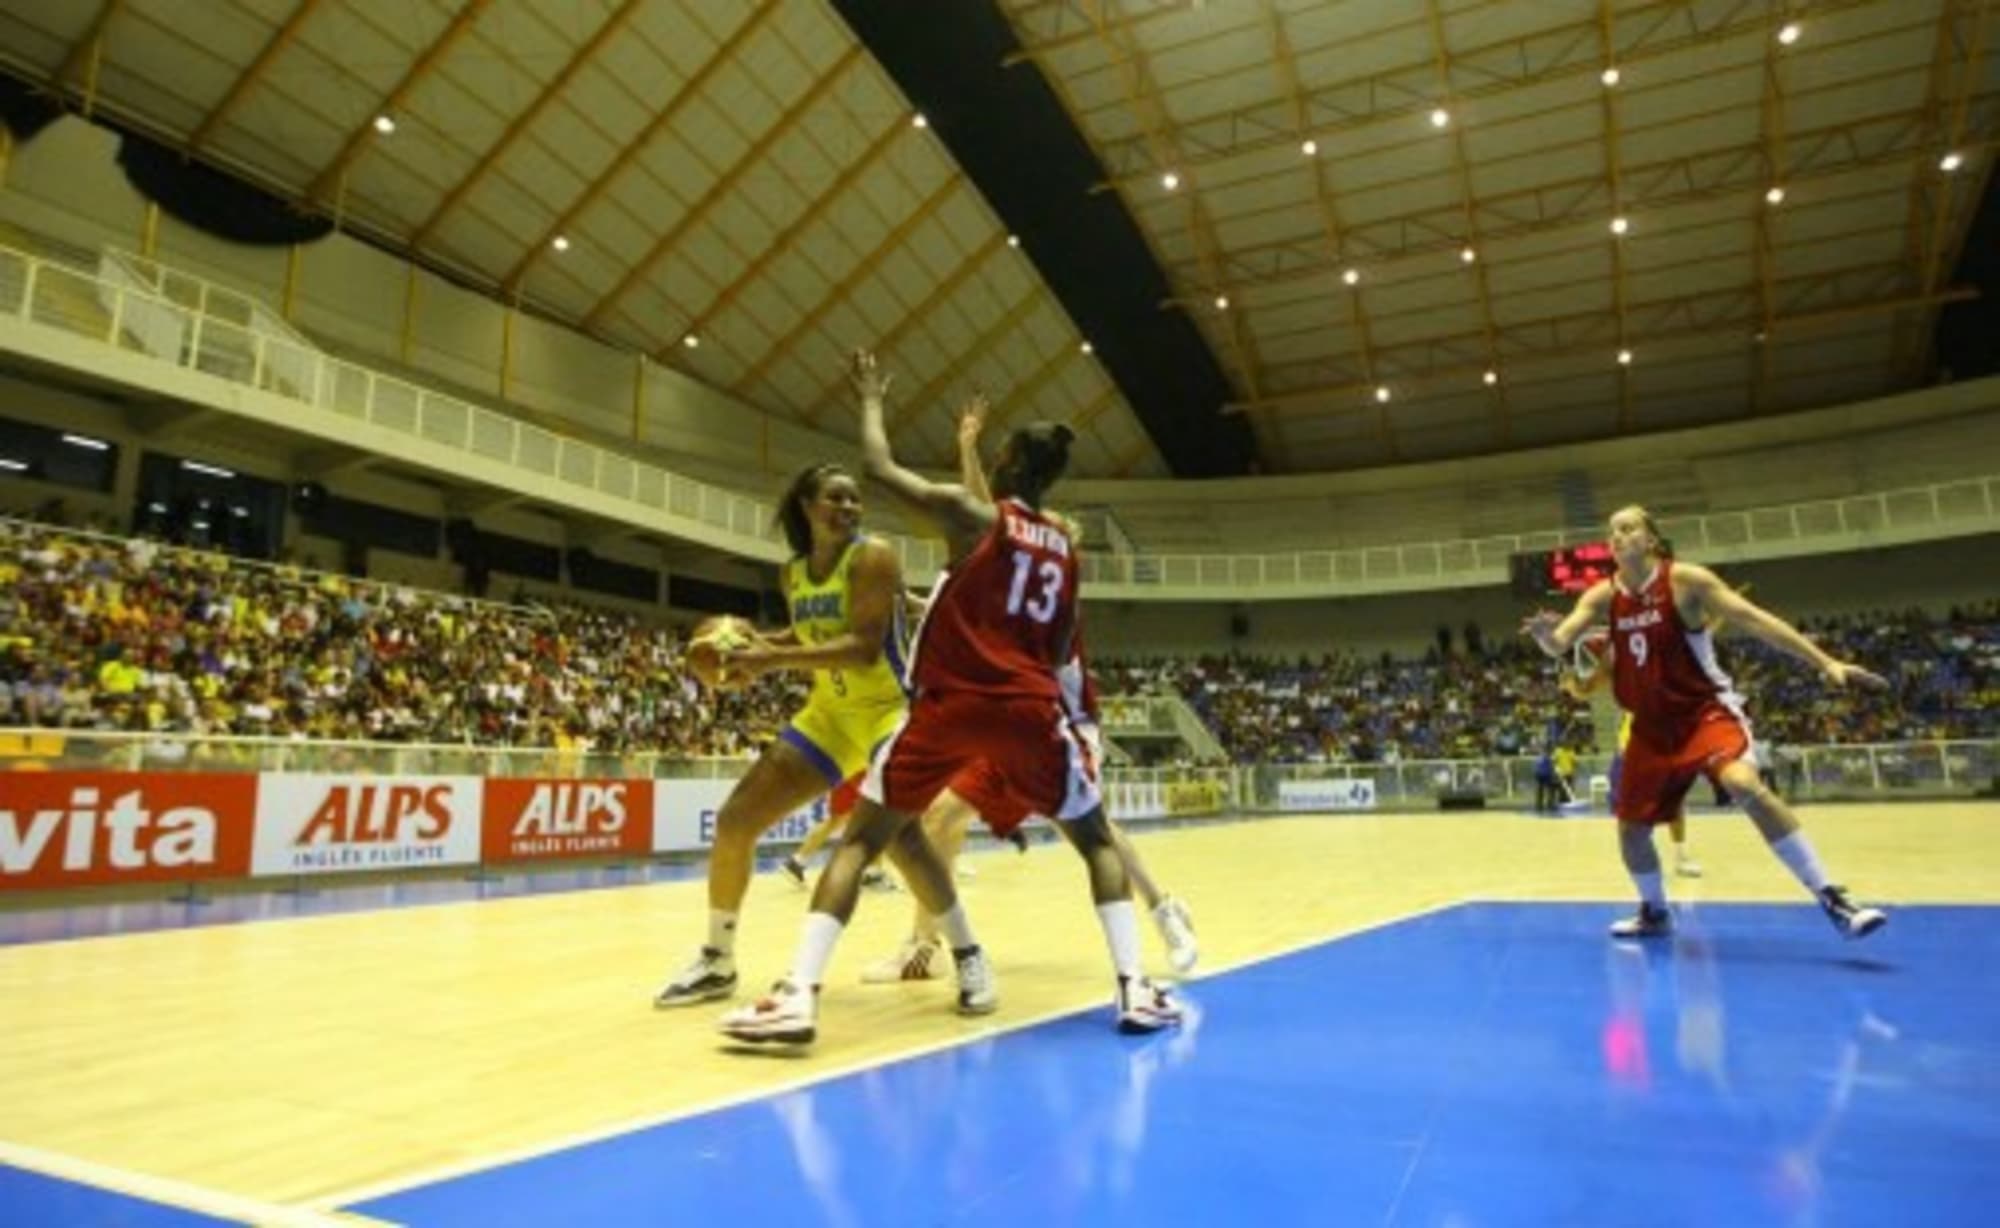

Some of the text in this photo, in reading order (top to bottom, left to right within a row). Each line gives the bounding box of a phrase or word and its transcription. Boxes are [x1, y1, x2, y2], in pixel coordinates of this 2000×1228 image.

[1007, 549, 1063, 622] 13
[1629, 632, 1647, 667] 9
[0, 787, 217, 873] vita
[294, 784, 454, 845] ALPS
[512, 783, 627, 835] ALPS
